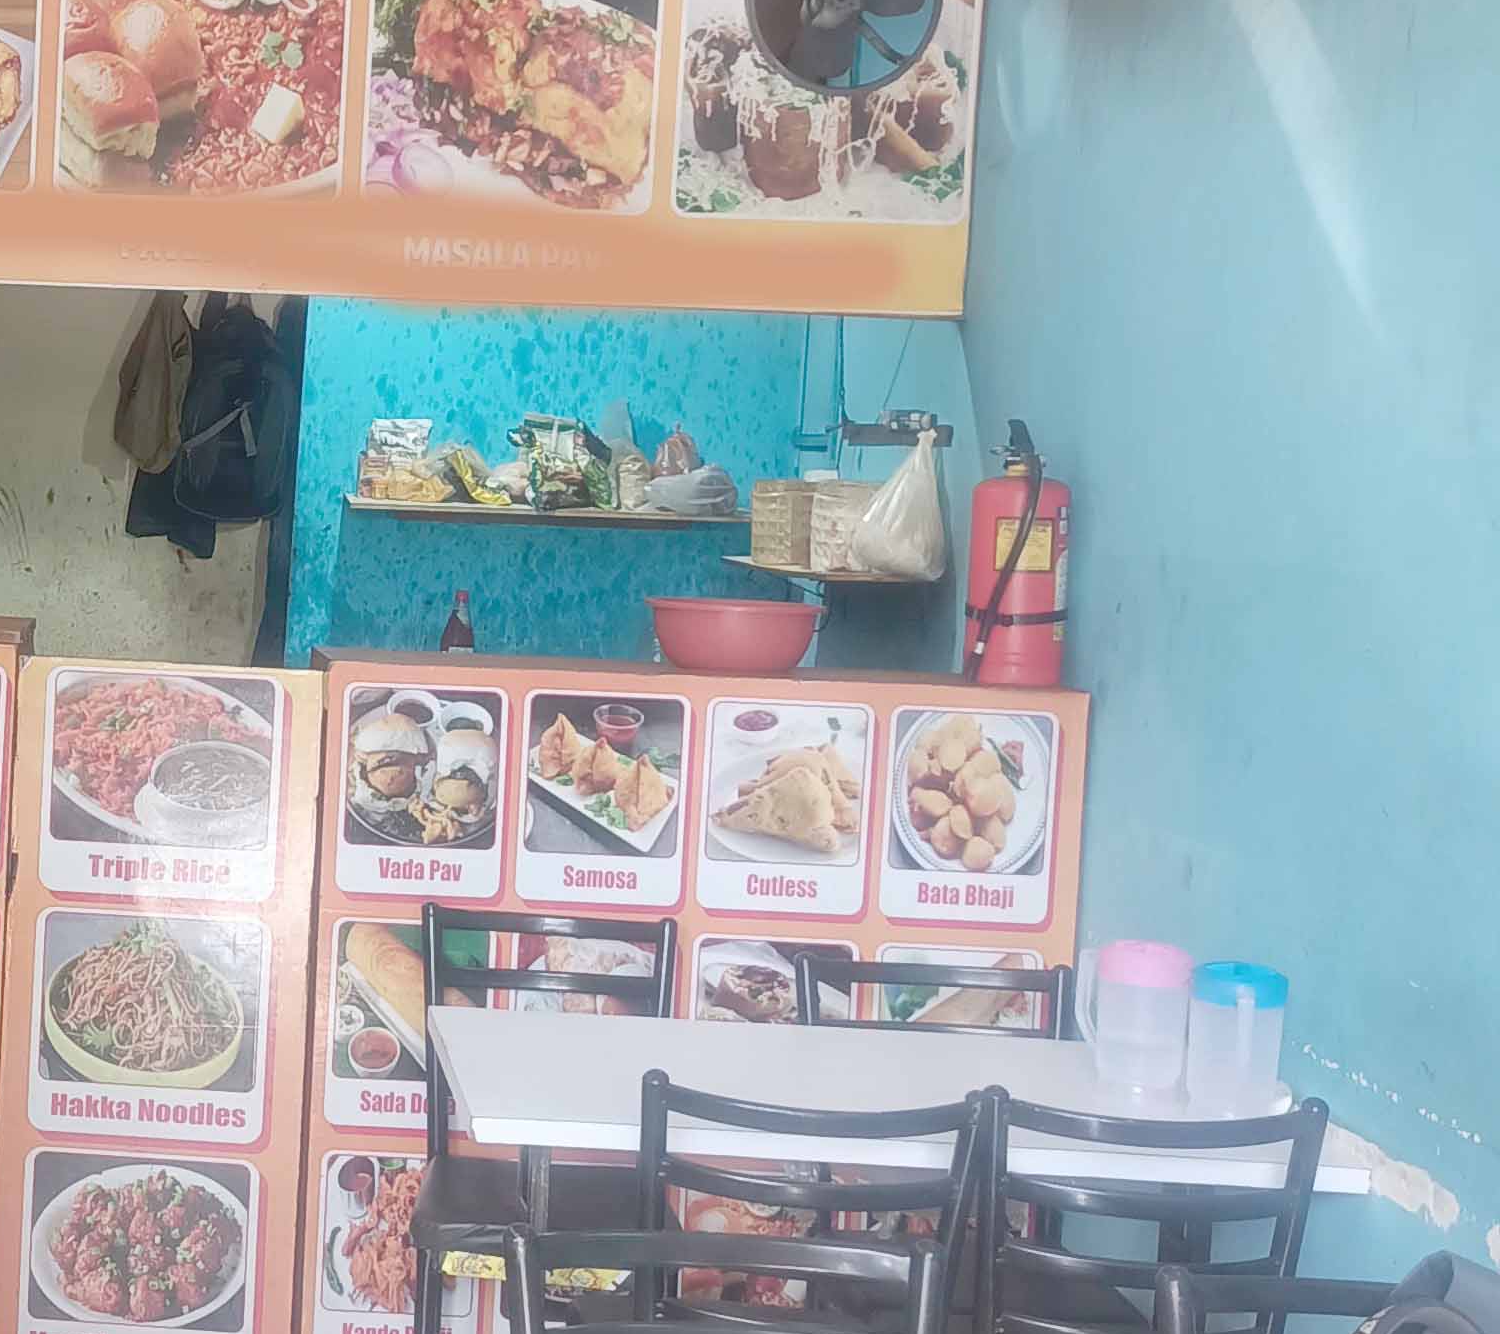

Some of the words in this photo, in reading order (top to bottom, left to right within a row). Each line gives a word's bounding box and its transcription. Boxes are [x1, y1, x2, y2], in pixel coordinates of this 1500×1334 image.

[88, 853, 166, 881] Triple
[172, 857, 231, 885] Rice
[378, 857, 424, 880] Vada
[429, 859, 462, 882] Pav
[563, 865, 638, 889] Samosa
[746, 873, 818, 899] Cutless
[917, 881, 960, 906] Bata
[964, 884, 1015, 909] Bhaji
[50, 1092, 132, 1120] Hakka
[138, 1098, 247, 1128] Noodles
[360, 1090, 406, 1114] Sada
